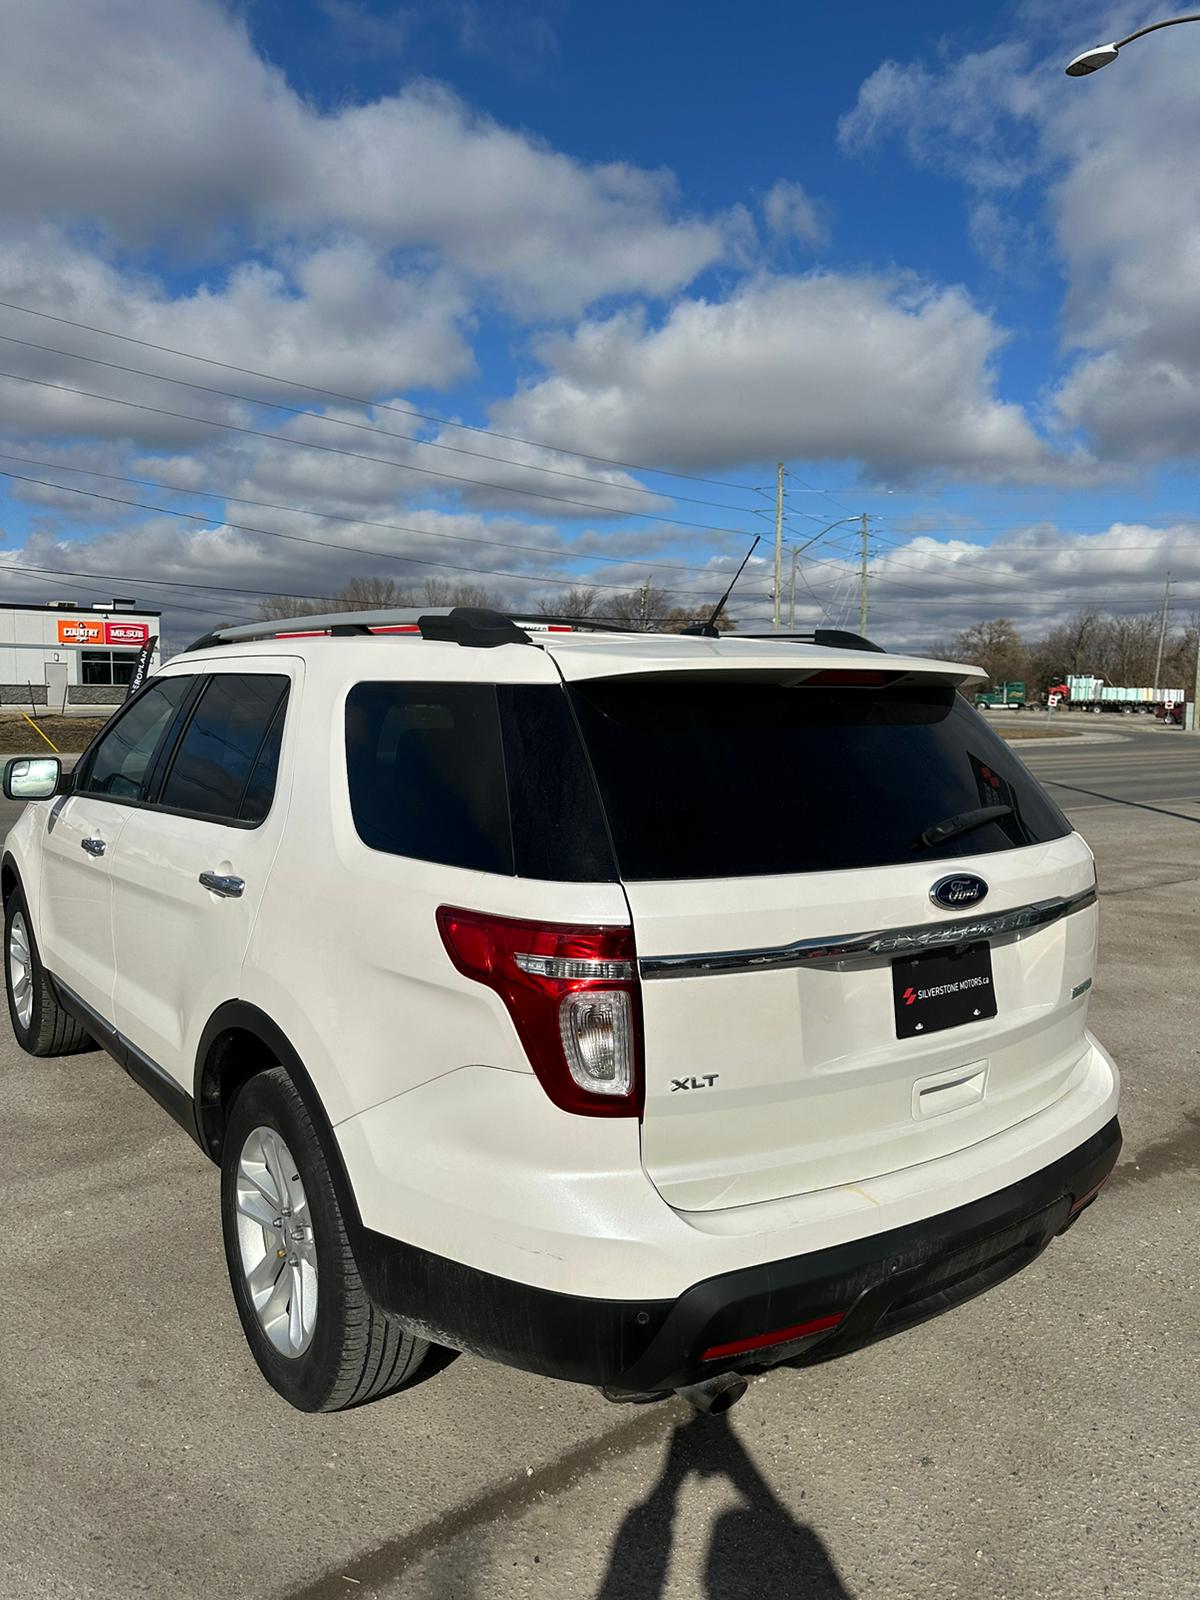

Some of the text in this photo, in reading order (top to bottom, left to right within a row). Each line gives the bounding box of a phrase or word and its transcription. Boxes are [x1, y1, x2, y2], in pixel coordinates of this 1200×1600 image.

[63, 627, 99, 638] COUNTRY
[948, 880, 979, 902] Ford
[917, 976, 990, 1000] SILVERSTONE MOTORS.ca
[671, 1074, 719, 1092] XLT
